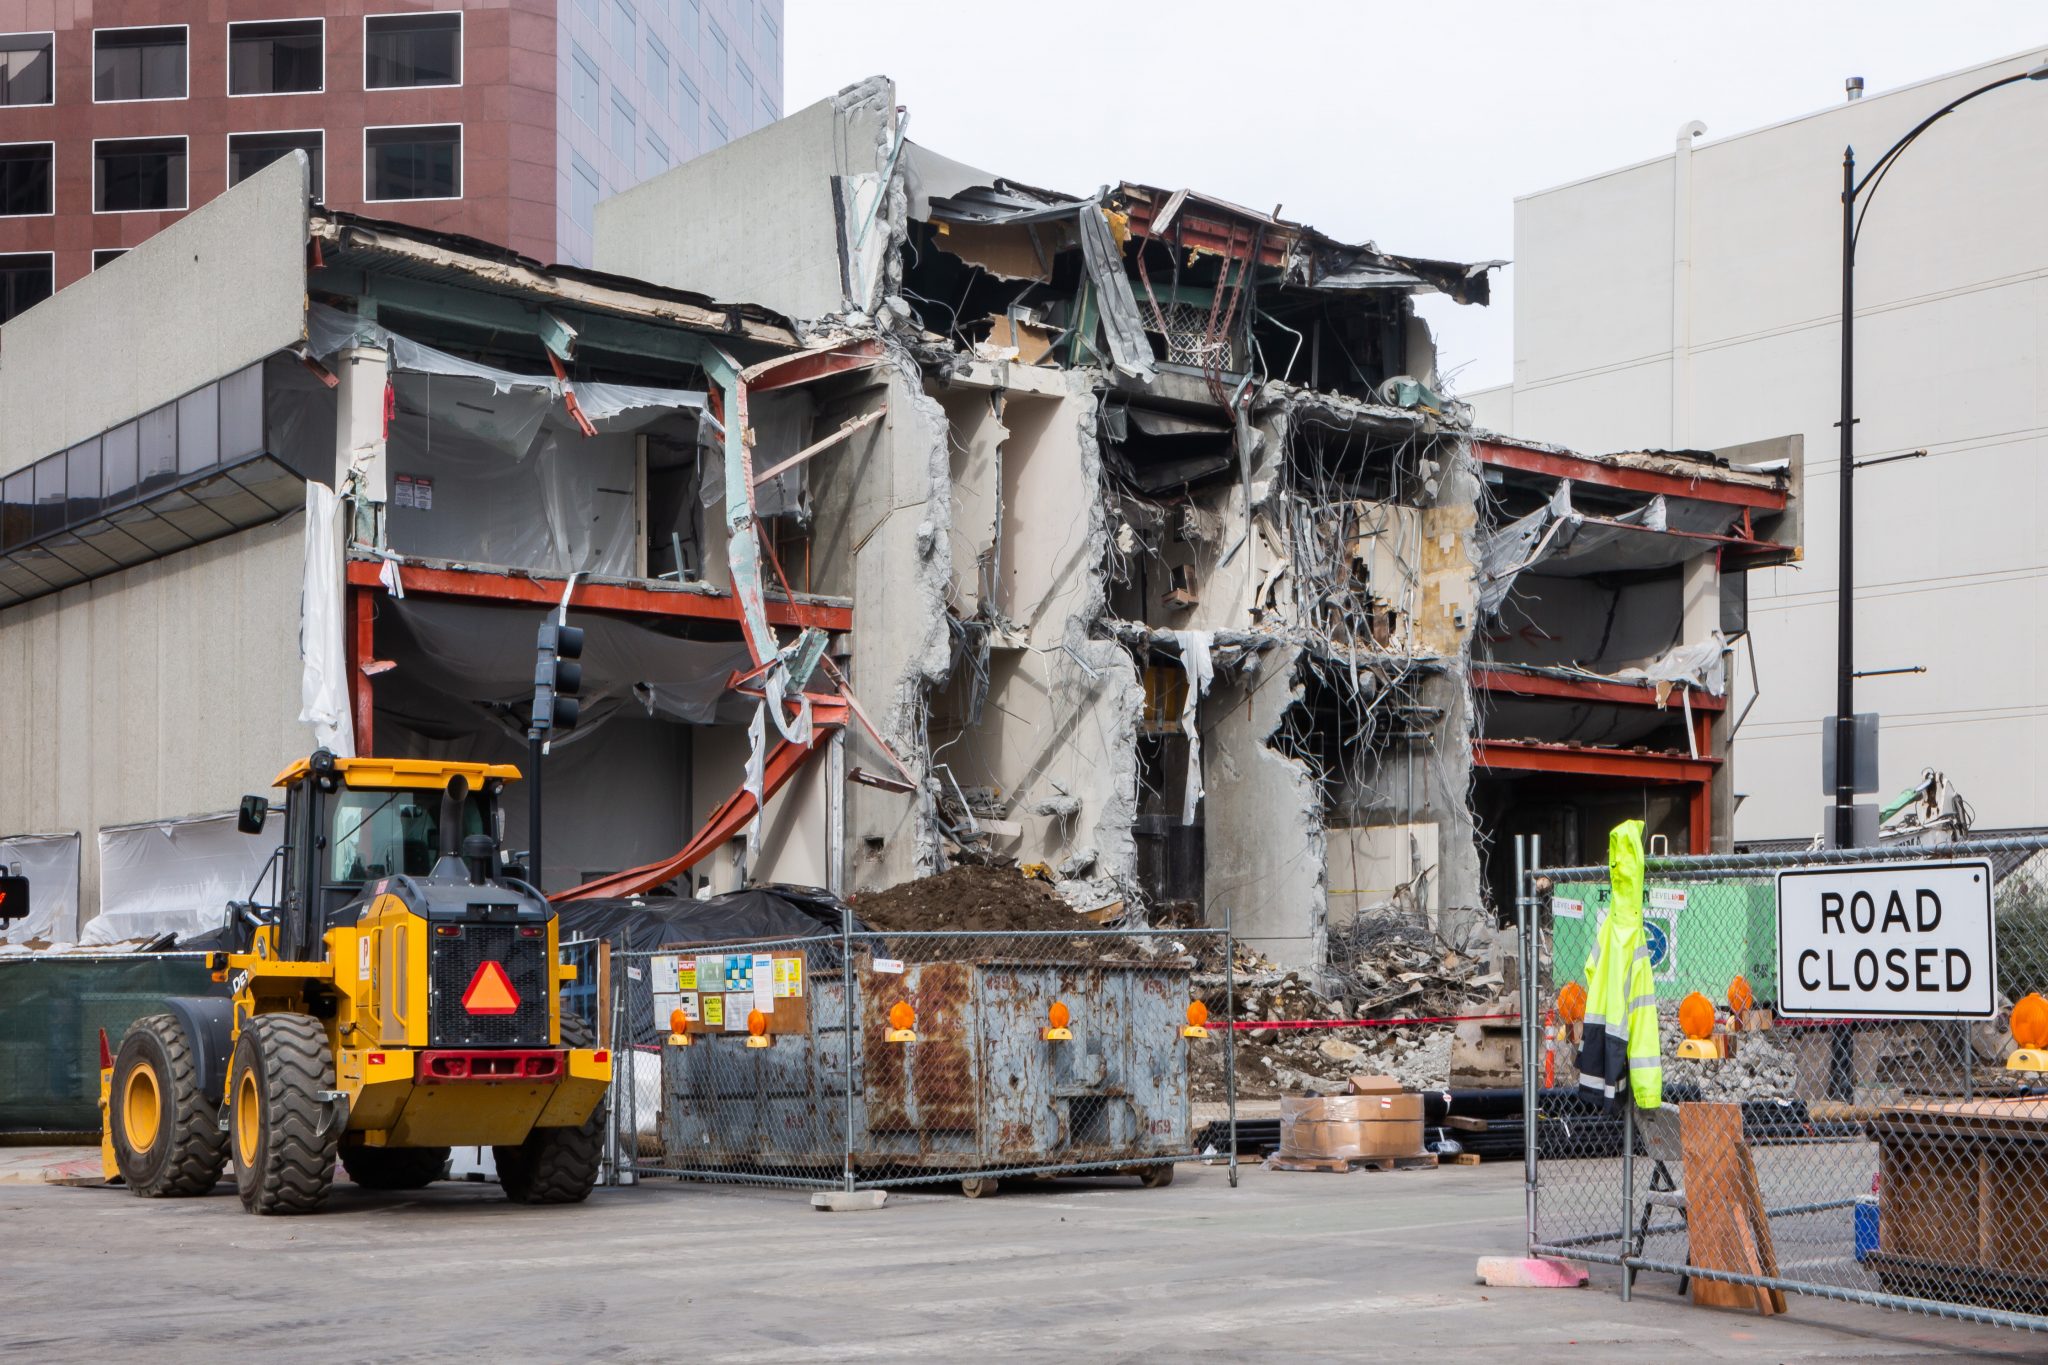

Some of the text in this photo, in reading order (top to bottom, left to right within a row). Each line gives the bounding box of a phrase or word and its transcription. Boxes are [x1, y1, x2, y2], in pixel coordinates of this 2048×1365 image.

[1554, 900, 1570, 910] LEVEL
[1652, 892, 1671, 900] LEVEL
[1821, 889, 1942, 934] ROAD
[1798, 948, 1972, 993] CLOSED
